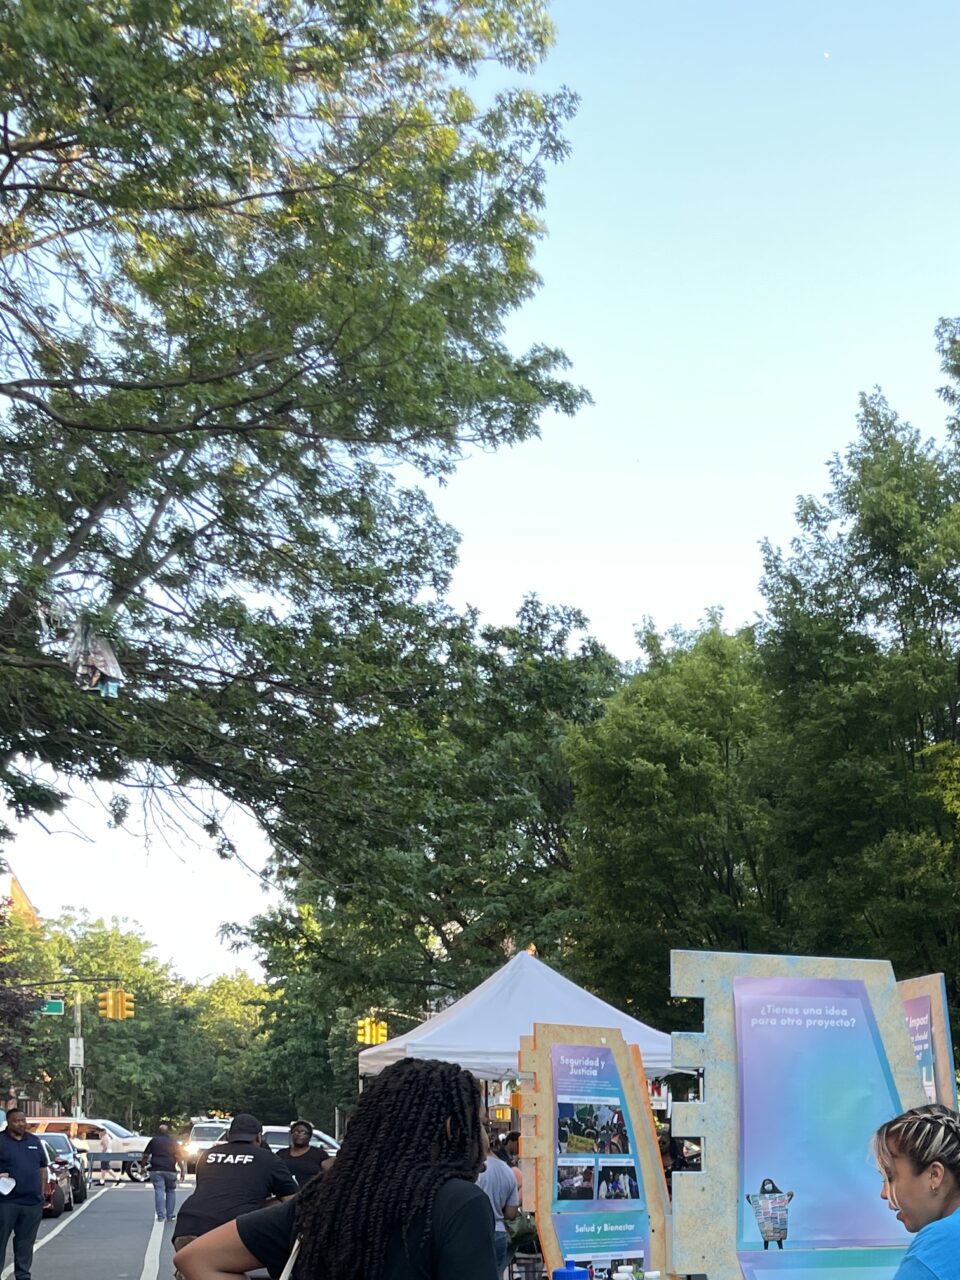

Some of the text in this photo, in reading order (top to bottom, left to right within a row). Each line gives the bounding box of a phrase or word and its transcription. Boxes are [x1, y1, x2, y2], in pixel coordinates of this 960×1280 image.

[761, 1004, 848, 1016] ¿Tienes una idea
[752, 1017, 777, 1027] para
[806, 1018, 856, 1029] proyecto?
[560, 1056, 605, 1069] Seguridad y
[569, 1066, 598, 1076] Justicia
[207, 1153, 254, 1164] STAFF
[576, 1225, 595, 1233] Salud
[604, 1224, 635, 1232] Bienestar
